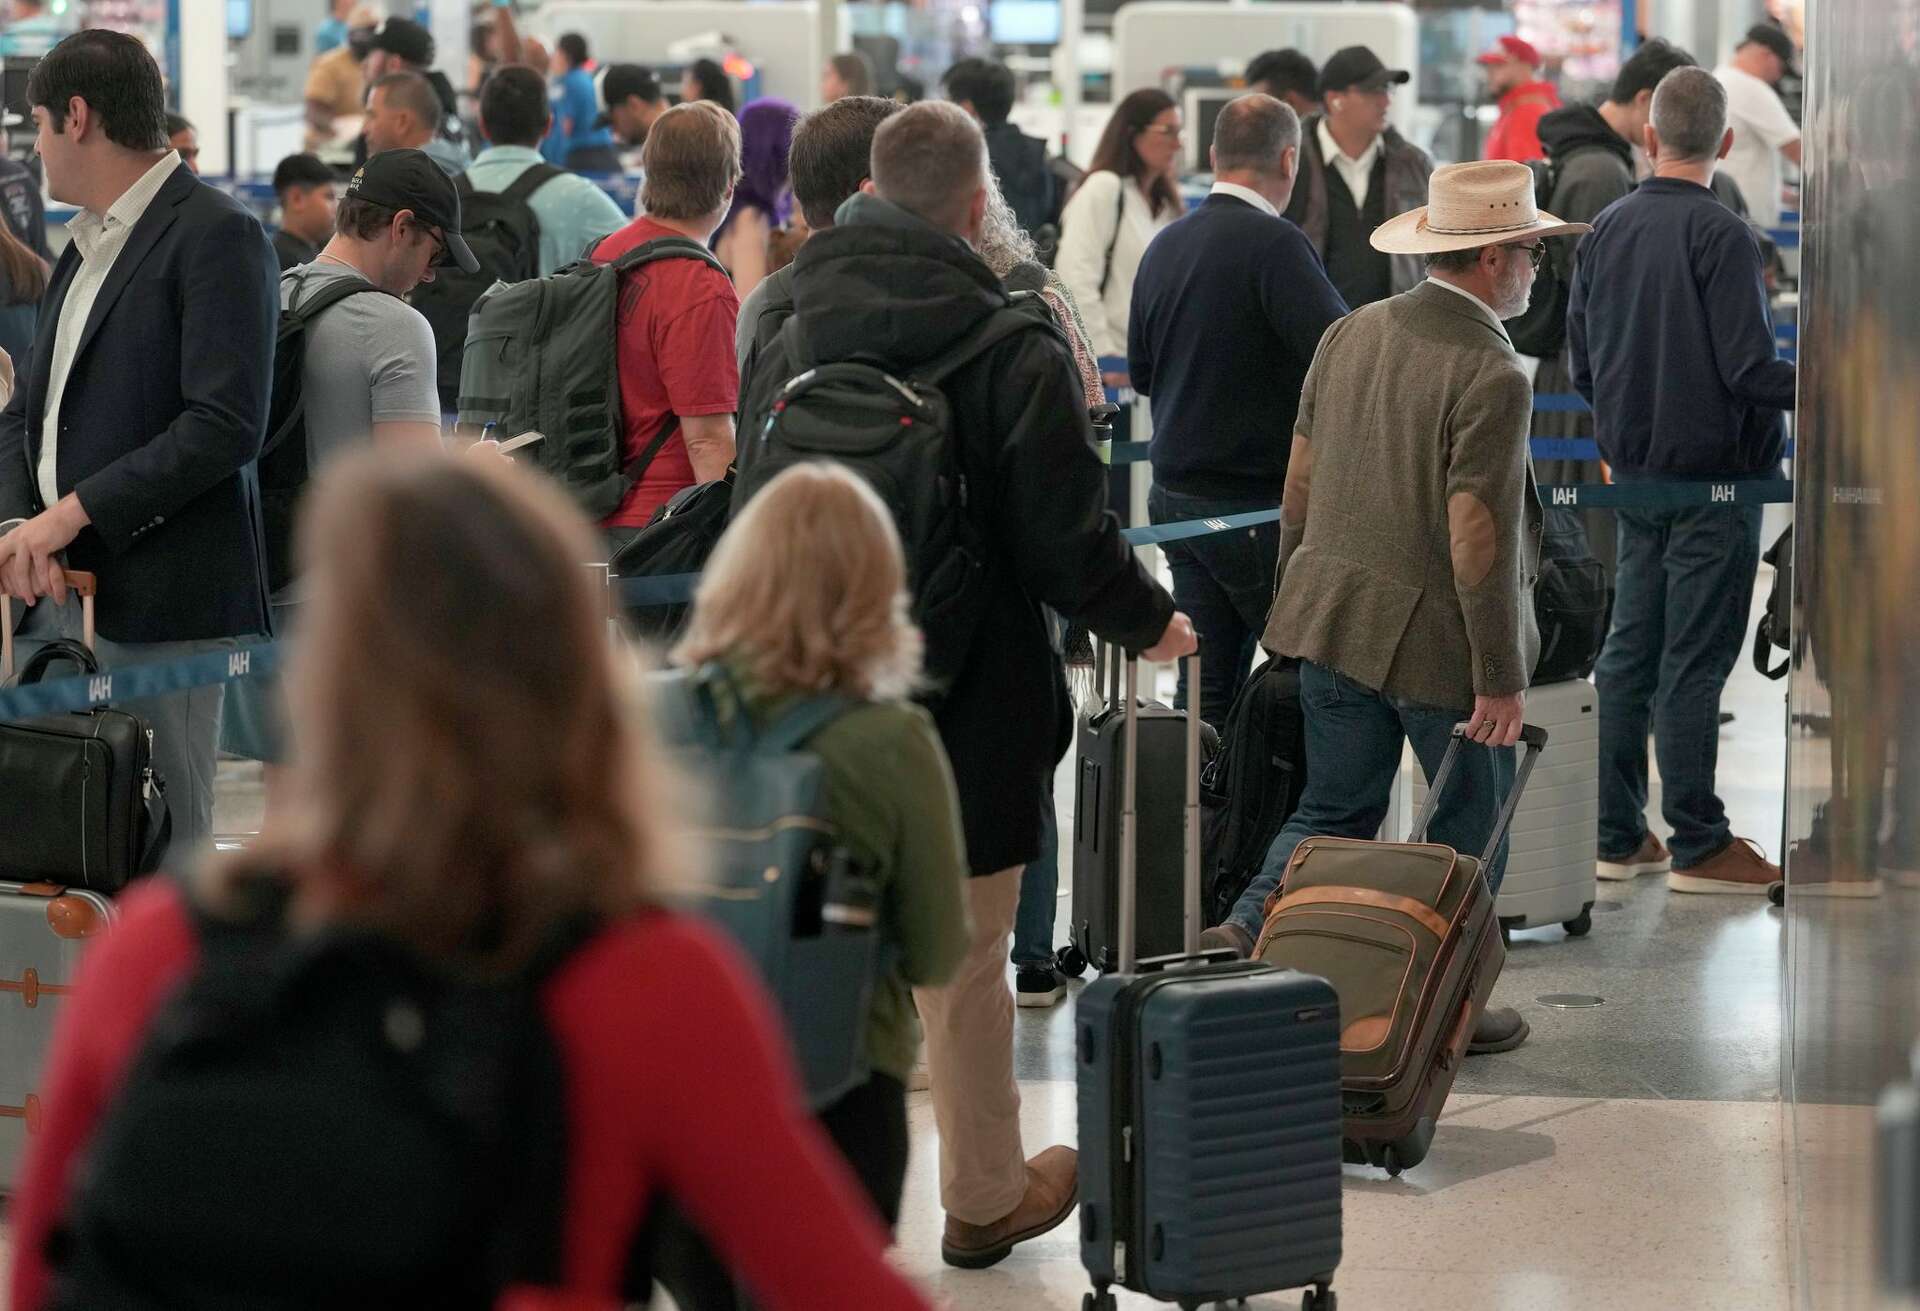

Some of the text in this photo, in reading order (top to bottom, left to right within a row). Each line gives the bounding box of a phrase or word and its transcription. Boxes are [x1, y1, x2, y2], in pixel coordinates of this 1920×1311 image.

[1552, 484, 1736, 505] IAH IAH
[88, 650, 251, 702] IAH IAH
